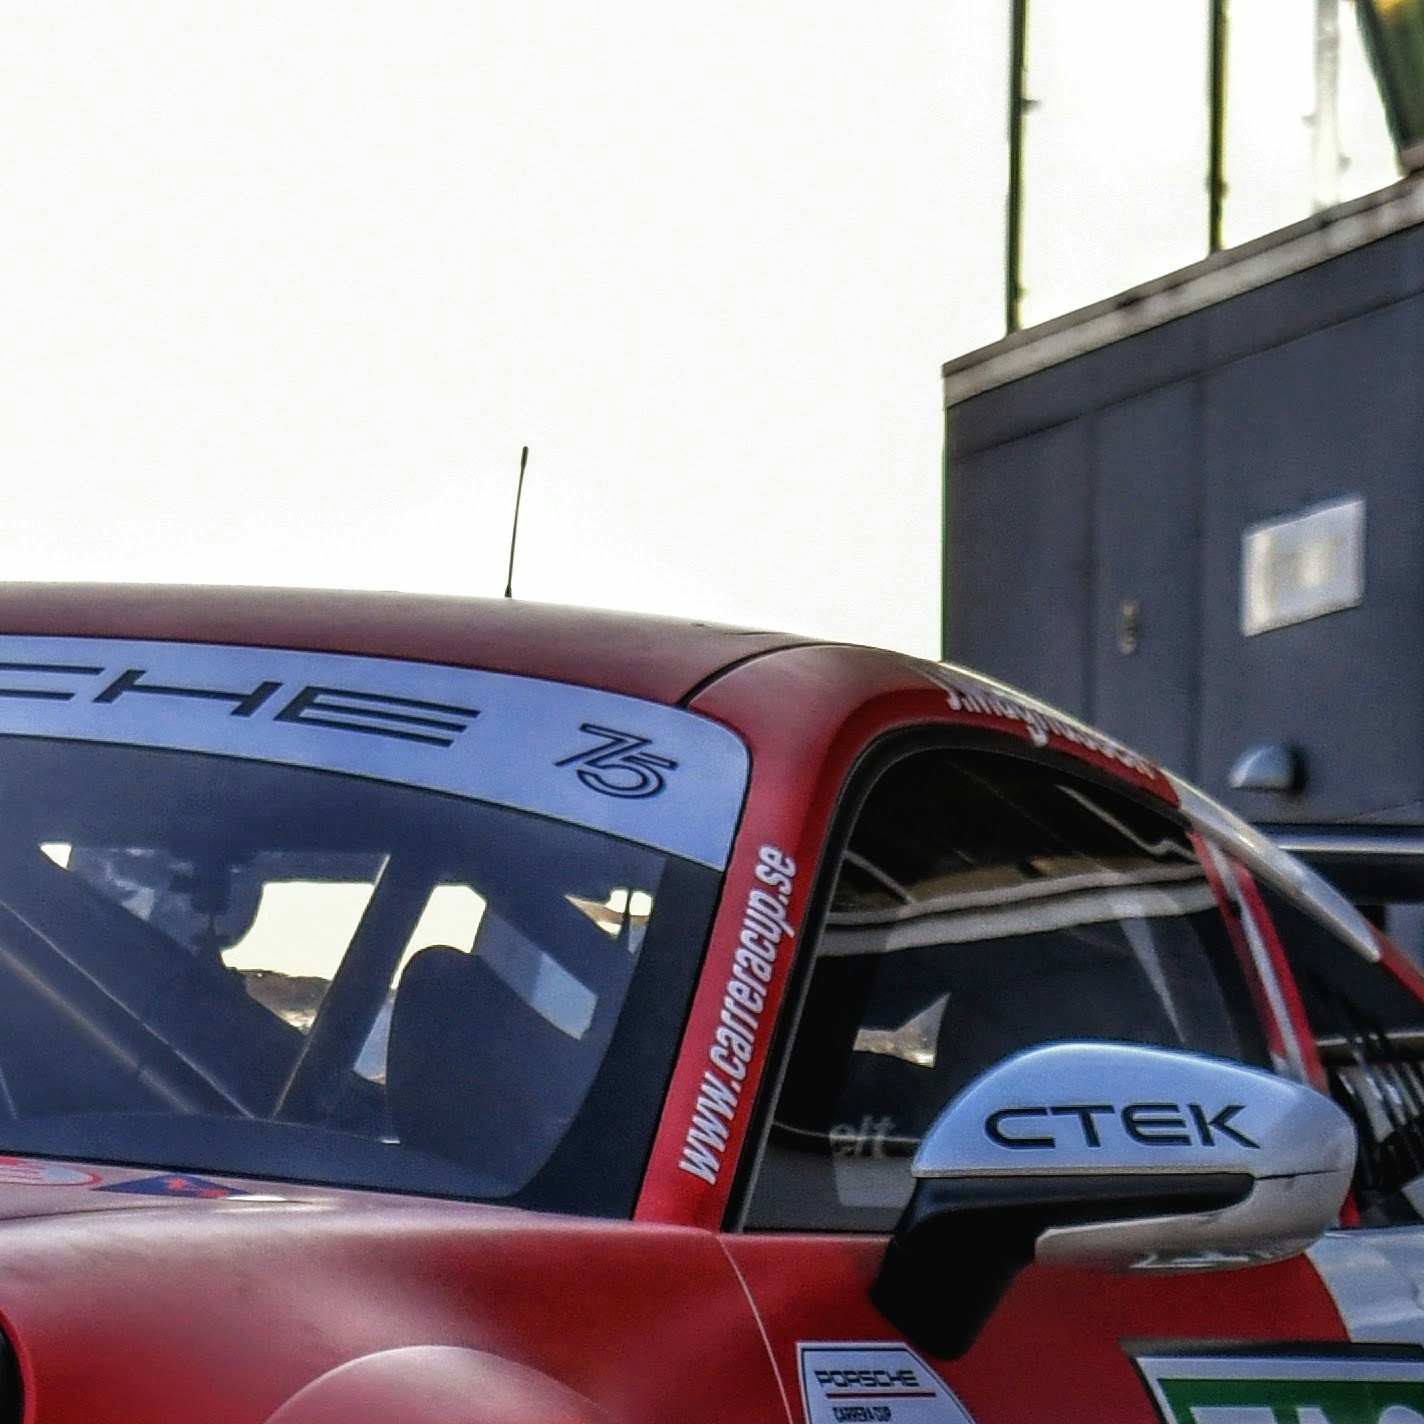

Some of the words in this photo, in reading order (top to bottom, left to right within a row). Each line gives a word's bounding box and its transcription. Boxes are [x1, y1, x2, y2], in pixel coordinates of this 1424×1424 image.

[553, 722, 679, 799] 75
[678, 845, 797, 1186] www.carreracup.se
[984, 1103, 1261, 1150] CTEK
[814, 1369, 920, 1388] PORSCHE
